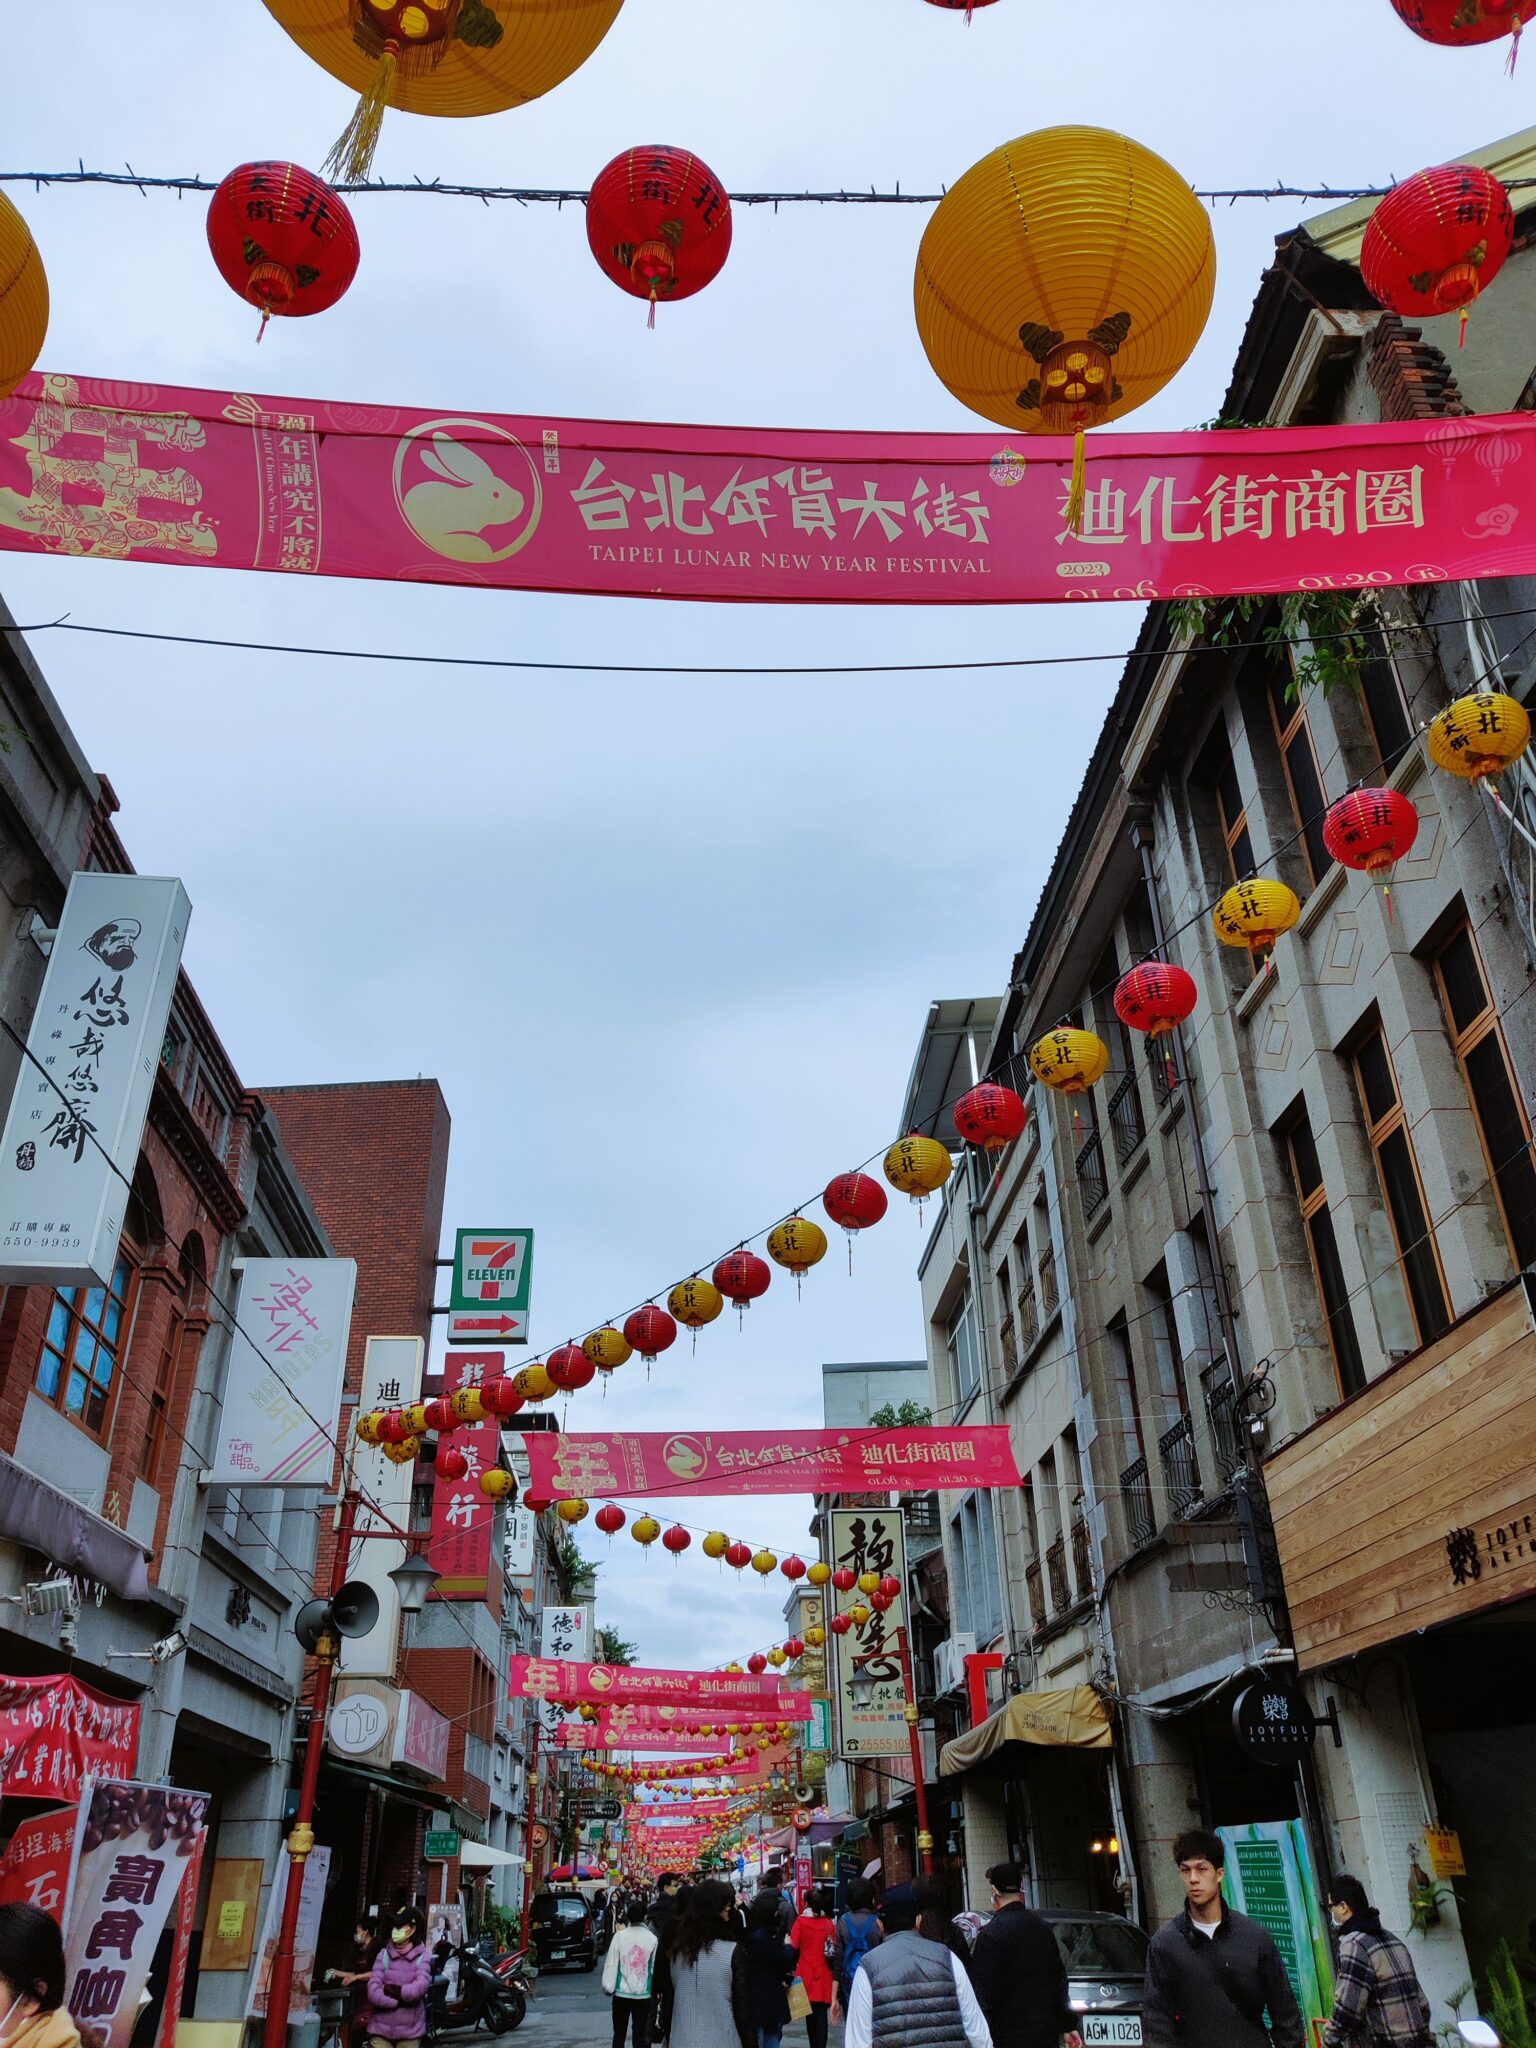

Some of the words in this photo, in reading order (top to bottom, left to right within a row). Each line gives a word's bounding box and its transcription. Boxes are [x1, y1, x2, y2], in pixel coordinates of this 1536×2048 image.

[278, 414, 316, 571] 過年講究不將就
[570, 457, 991, 545] 台北年貨大街
[1055, 463, 1425, 546] 迪化街商圈
[588, 544, 664, 564] TAIPEI
[674, 548, 753, 568] LUNAR
[760, 552, 812, 571] NEW
[820, 555, 878, 573] YEAR
[886, 557, 991, 574] FESTIVAL
[1298, 570, 1393, 590] 01.20
[1472, 694, 1503, 735] 台北
[1236, 883, 1264, 920] 台北
[1052, 1031, 1074, 1065] 台北
[899, 1141, 917, 1174] 台北
[10, 1221, 71, 1234] 訂購專線
[782, 1222, 800, 1251] 台北
[0, 1237, 81, 1249] 550-9939
[683, 1281, 697, 1308] 台北
[715, 1443, 844, 1468] 台北年貨大街
[861, 1439, 977, 1465] 迪化街商圈
[868, 1475, 898, 1486] 01.06
[938, 1474, 968, 1483] 01.20
[1486, 1513, 1536, 1552] JOYF
[551, 1611, 574, 1657] 德和
[1249, 1725, 1309, 1735] JOYFUL
[1085, 2022, 1141, 2041] AGM-1028
